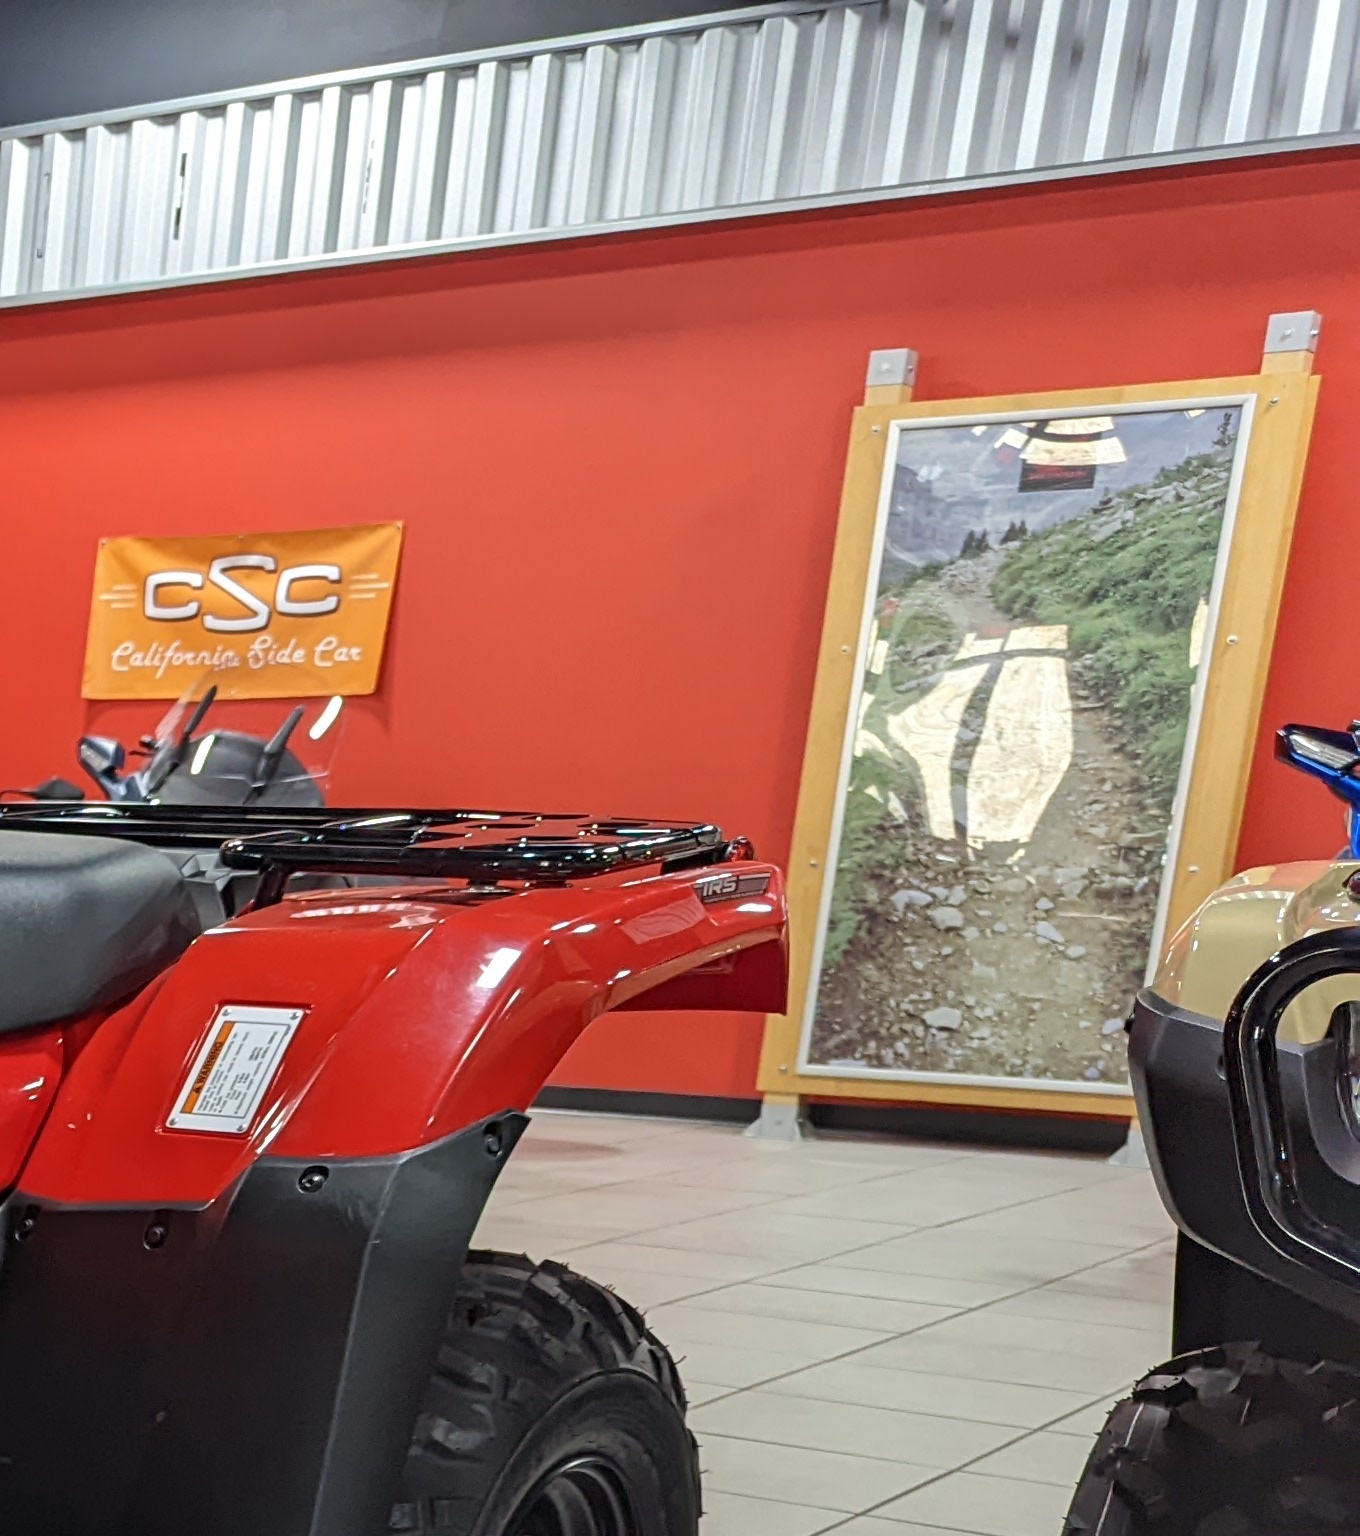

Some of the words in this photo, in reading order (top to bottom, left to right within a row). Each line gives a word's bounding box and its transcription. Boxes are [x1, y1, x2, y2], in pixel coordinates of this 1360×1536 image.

[143, 554, 342, 634] CSC
[111, 639, 240, 679] California
[247, 635, 307, 669] Side
[314, 636, 363, 667] Car
[703, 877, 737, 896] IRS
[196, 1041, 223, 1087] WARNING
